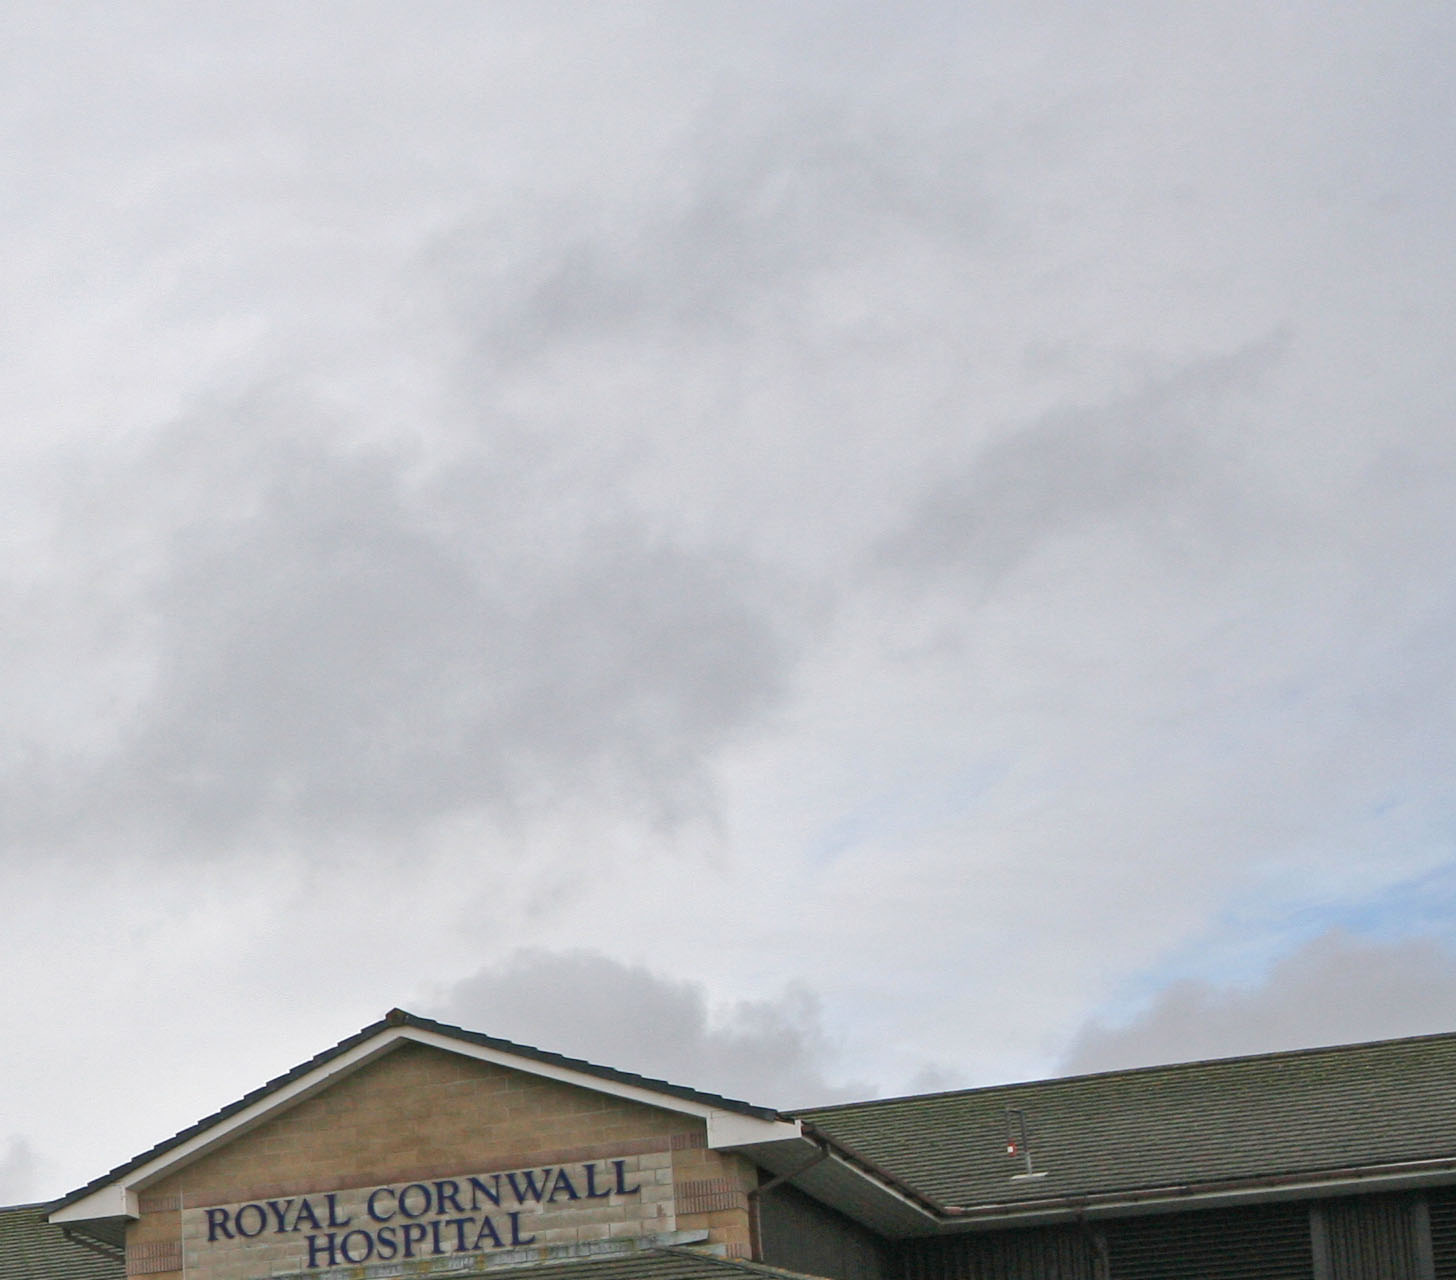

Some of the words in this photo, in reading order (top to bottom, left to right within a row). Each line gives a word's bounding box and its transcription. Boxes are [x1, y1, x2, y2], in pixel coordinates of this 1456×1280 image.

[204, 1193, 351, 1242] ROYAL
[367, 1159, 641, 1223] CORNWALL
[305, 1211, 536, 1269] HOSPITAL
